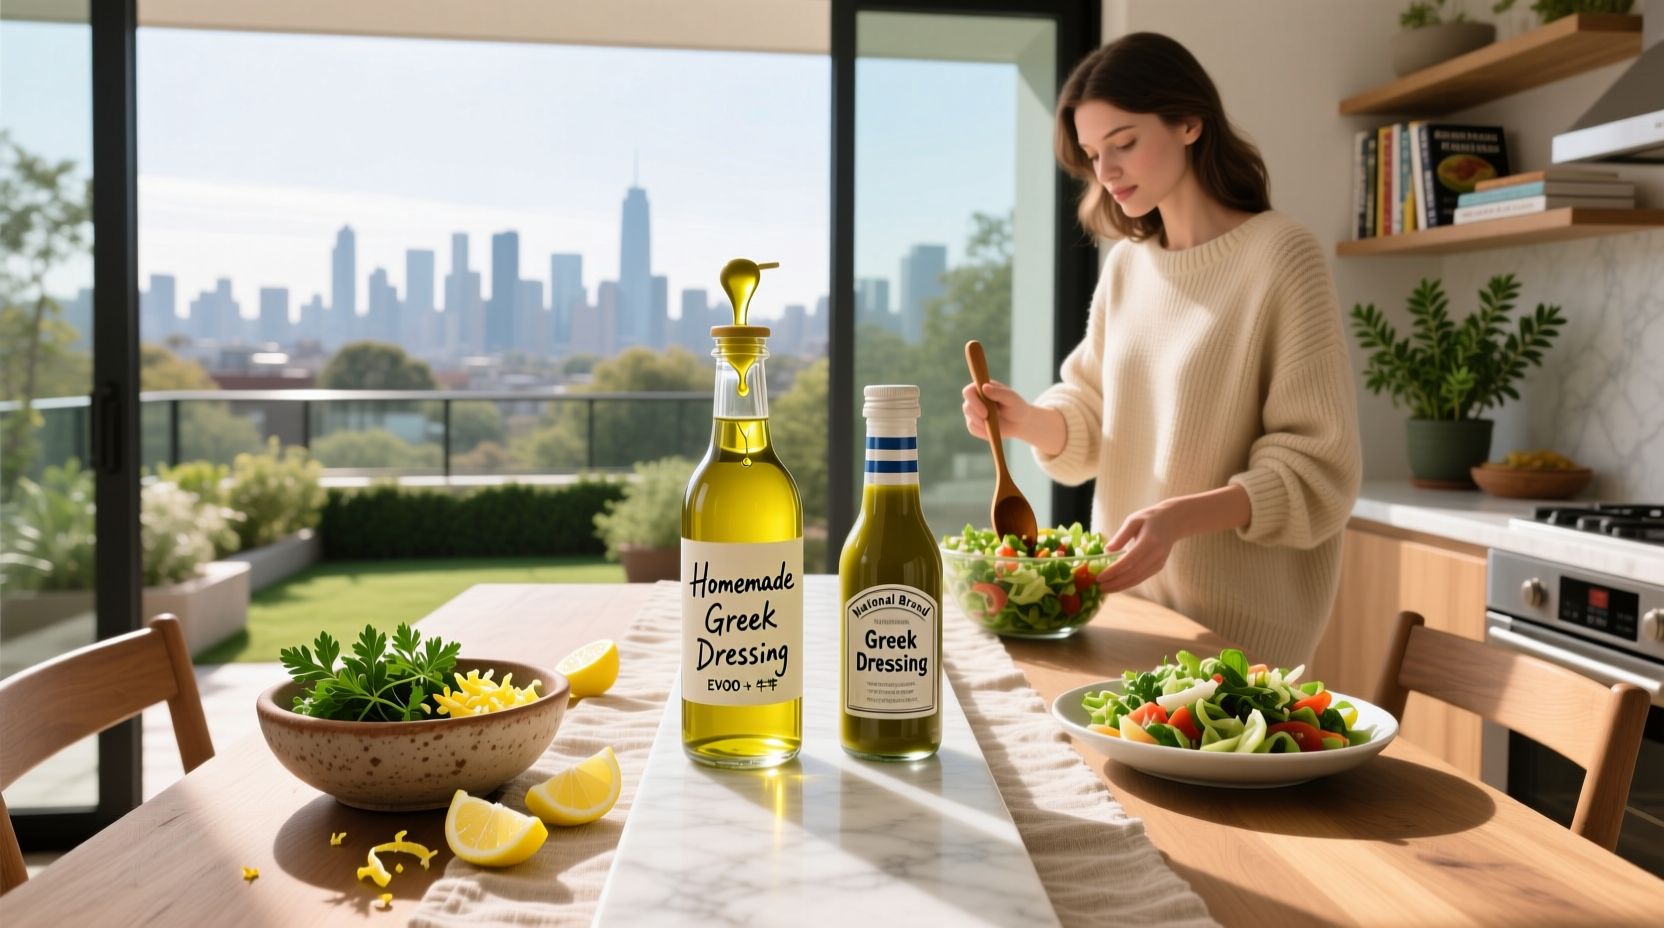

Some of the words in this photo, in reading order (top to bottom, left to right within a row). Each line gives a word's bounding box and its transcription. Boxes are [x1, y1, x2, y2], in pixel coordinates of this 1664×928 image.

[690, 561, 795, 598] Homemade
[705, 600, 777, 636] Greek
[865, 629, 917, 649] Greek
[697, 637, 788, 677] Dressing
[856, 651, 928, 677] Dressing
[708, 679, 740, 692] EVOO
